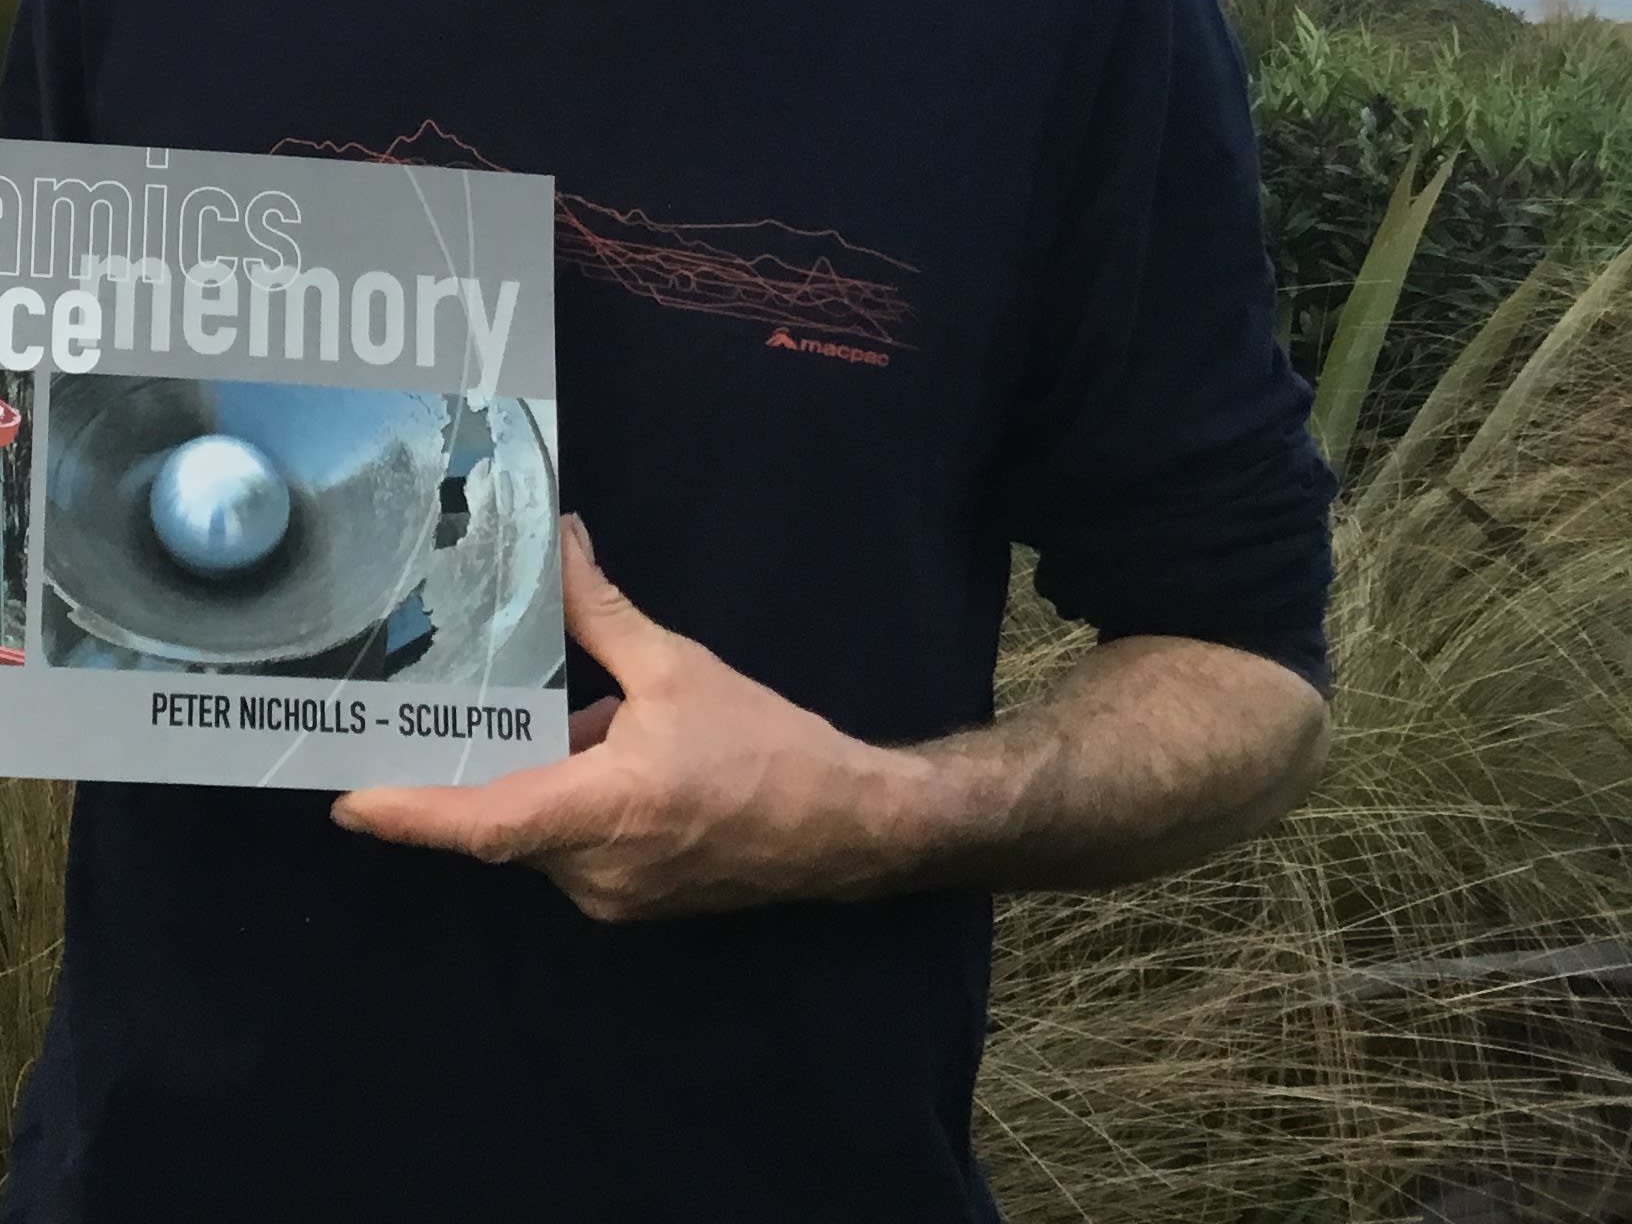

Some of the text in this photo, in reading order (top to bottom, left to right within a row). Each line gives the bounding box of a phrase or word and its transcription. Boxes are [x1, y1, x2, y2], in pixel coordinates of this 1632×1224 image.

[80, 252, 521, 410] memory
[800, 338, 889, 367] macpac
[151, 692, 231, 729] PETER
[239, 696, 366, 734] NICHOLLS
[398, 703, 533, 741] SCULPTOR
